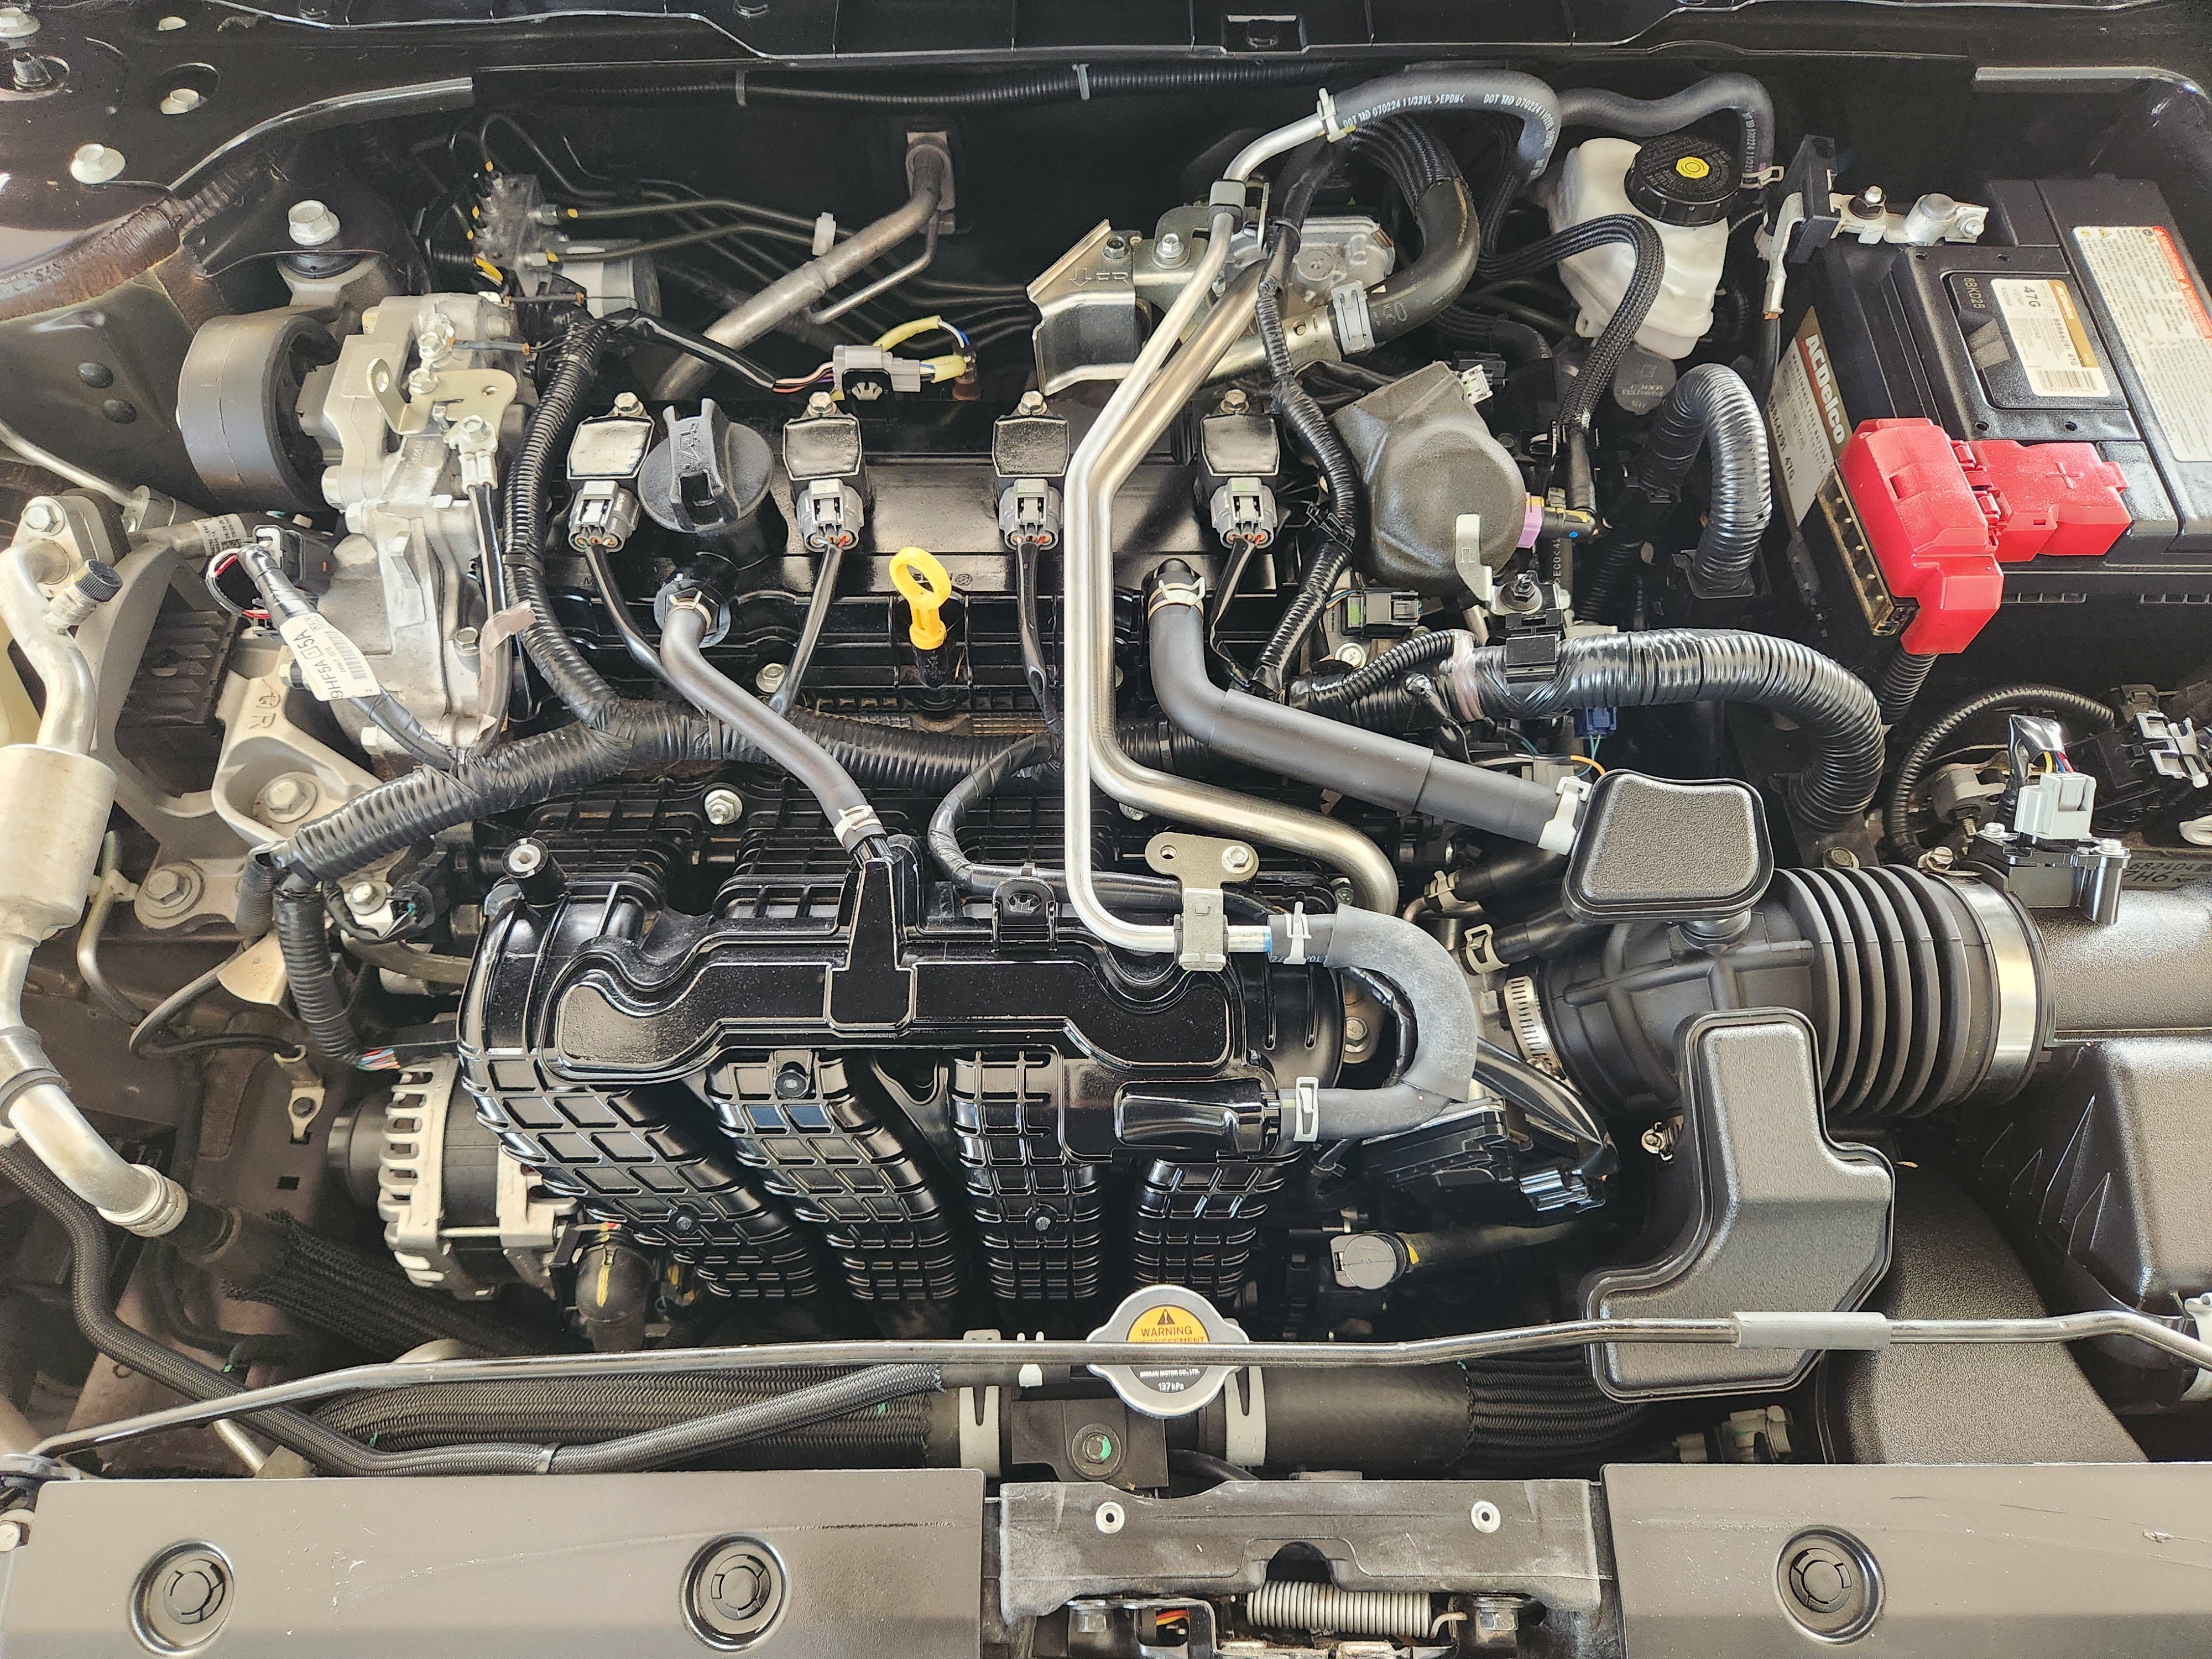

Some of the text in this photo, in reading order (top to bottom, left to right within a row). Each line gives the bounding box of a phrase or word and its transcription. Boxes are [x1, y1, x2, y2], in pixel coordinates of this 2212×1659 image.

[1372, 99, 1401, 118] 070224
[1483, 93, 1500, 105] DOT
[1515, 97, 1542, 114] 070224
[1963, 277, 1986, 309] 6BKD25
[2023, 286, 2041, 308] 47G
[1806, 333, 1845, 444] ACDelco
[1141, 1326, 1192, 1337] WARNING
[1140, 1370, 1159, 1378] NISSAN
